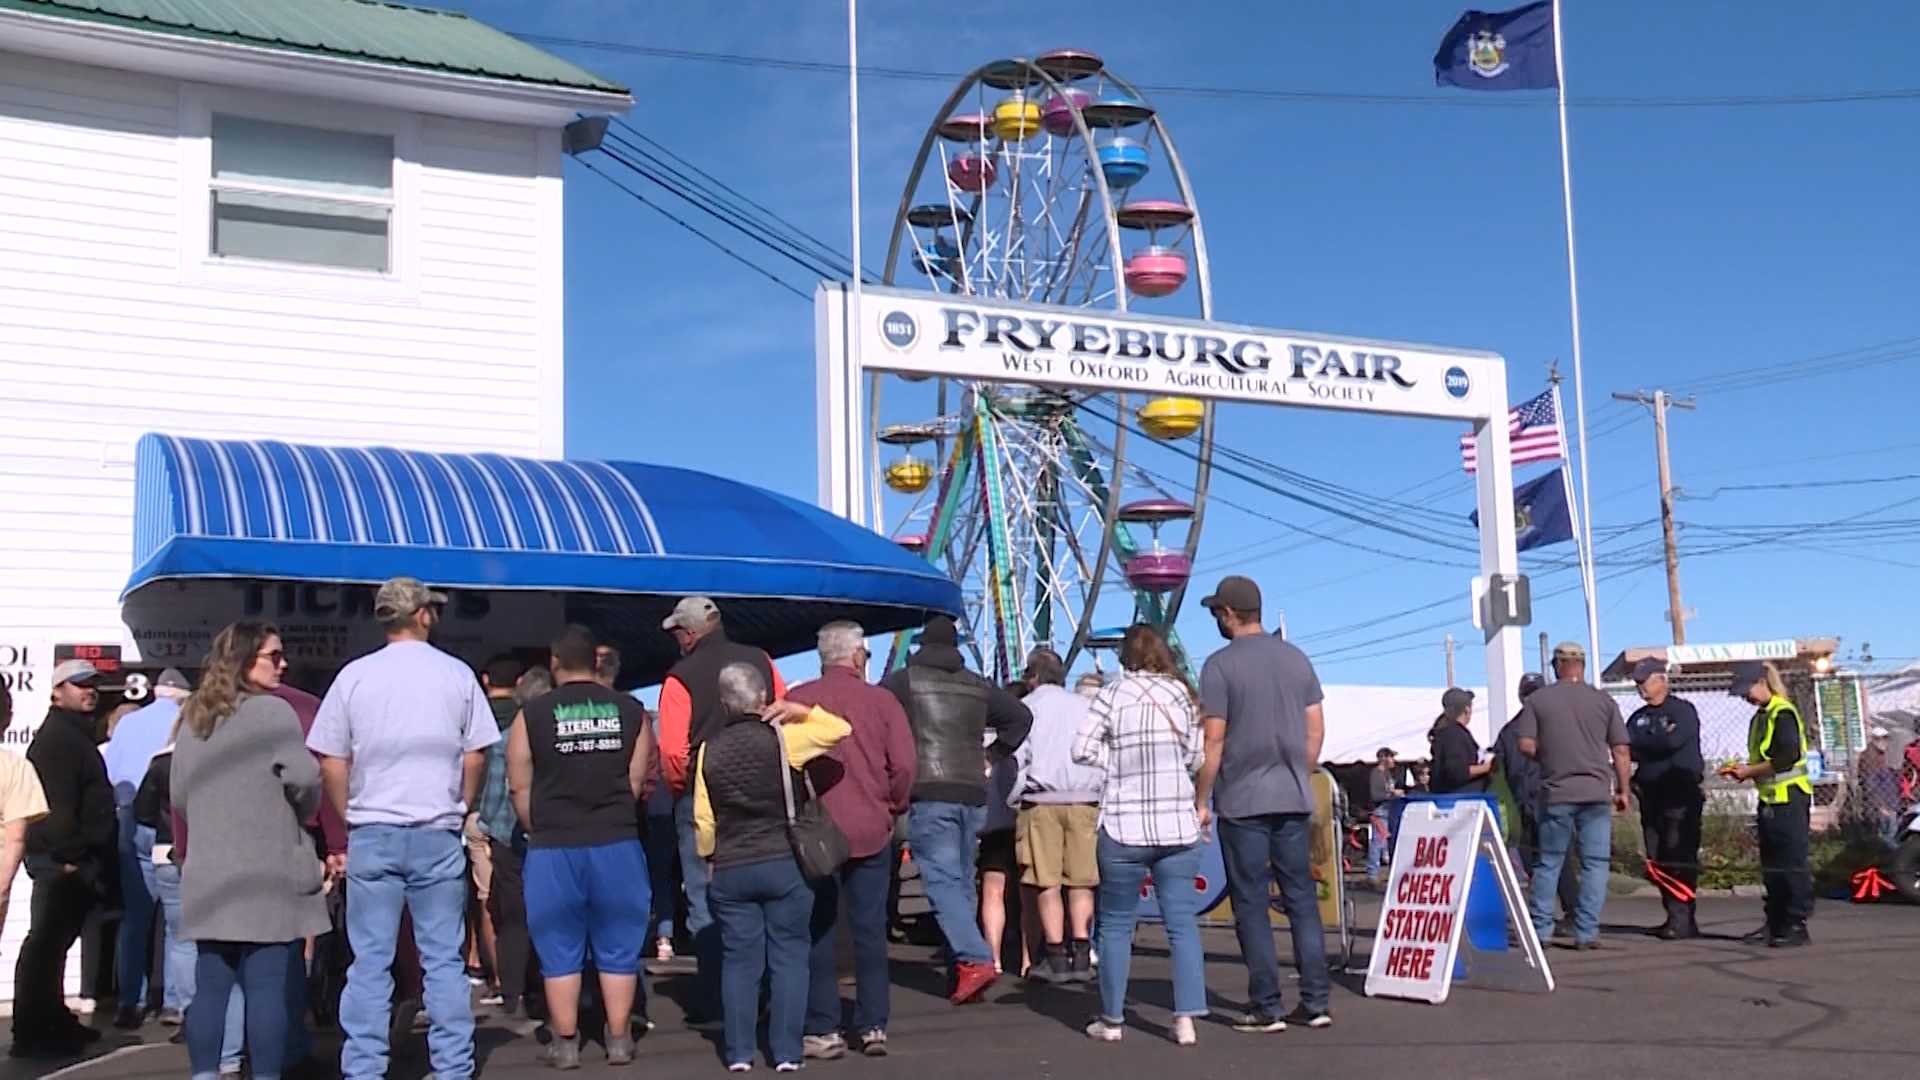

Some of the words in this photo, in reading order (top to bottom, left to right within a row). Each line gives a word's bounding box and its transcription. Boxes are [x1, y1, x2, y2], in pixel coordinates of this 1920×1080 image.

[940, 307, 1272, 375] FRYEBURG
[1287, 344, 1417, 390] FAIR
[1002, 352, 1053, 375] WEST
[1070, 358, 1149, 383] OXFORD
[1165, 368, 1288, 395] AGRICULTURAL
[1308, 380, 1375, 402] SOCIETY
[232, 583, 490, 619] TICKS
[124, 673, 149, 701] 3
[557, 717, 621, 734] STERLING
[1413, 835, 1449, 868] BAG
[1397, 872, 1456, 906] CHECK
[1383, 908, 1454, 944] STATION
[1385, 946, 1436, 979] HERE
